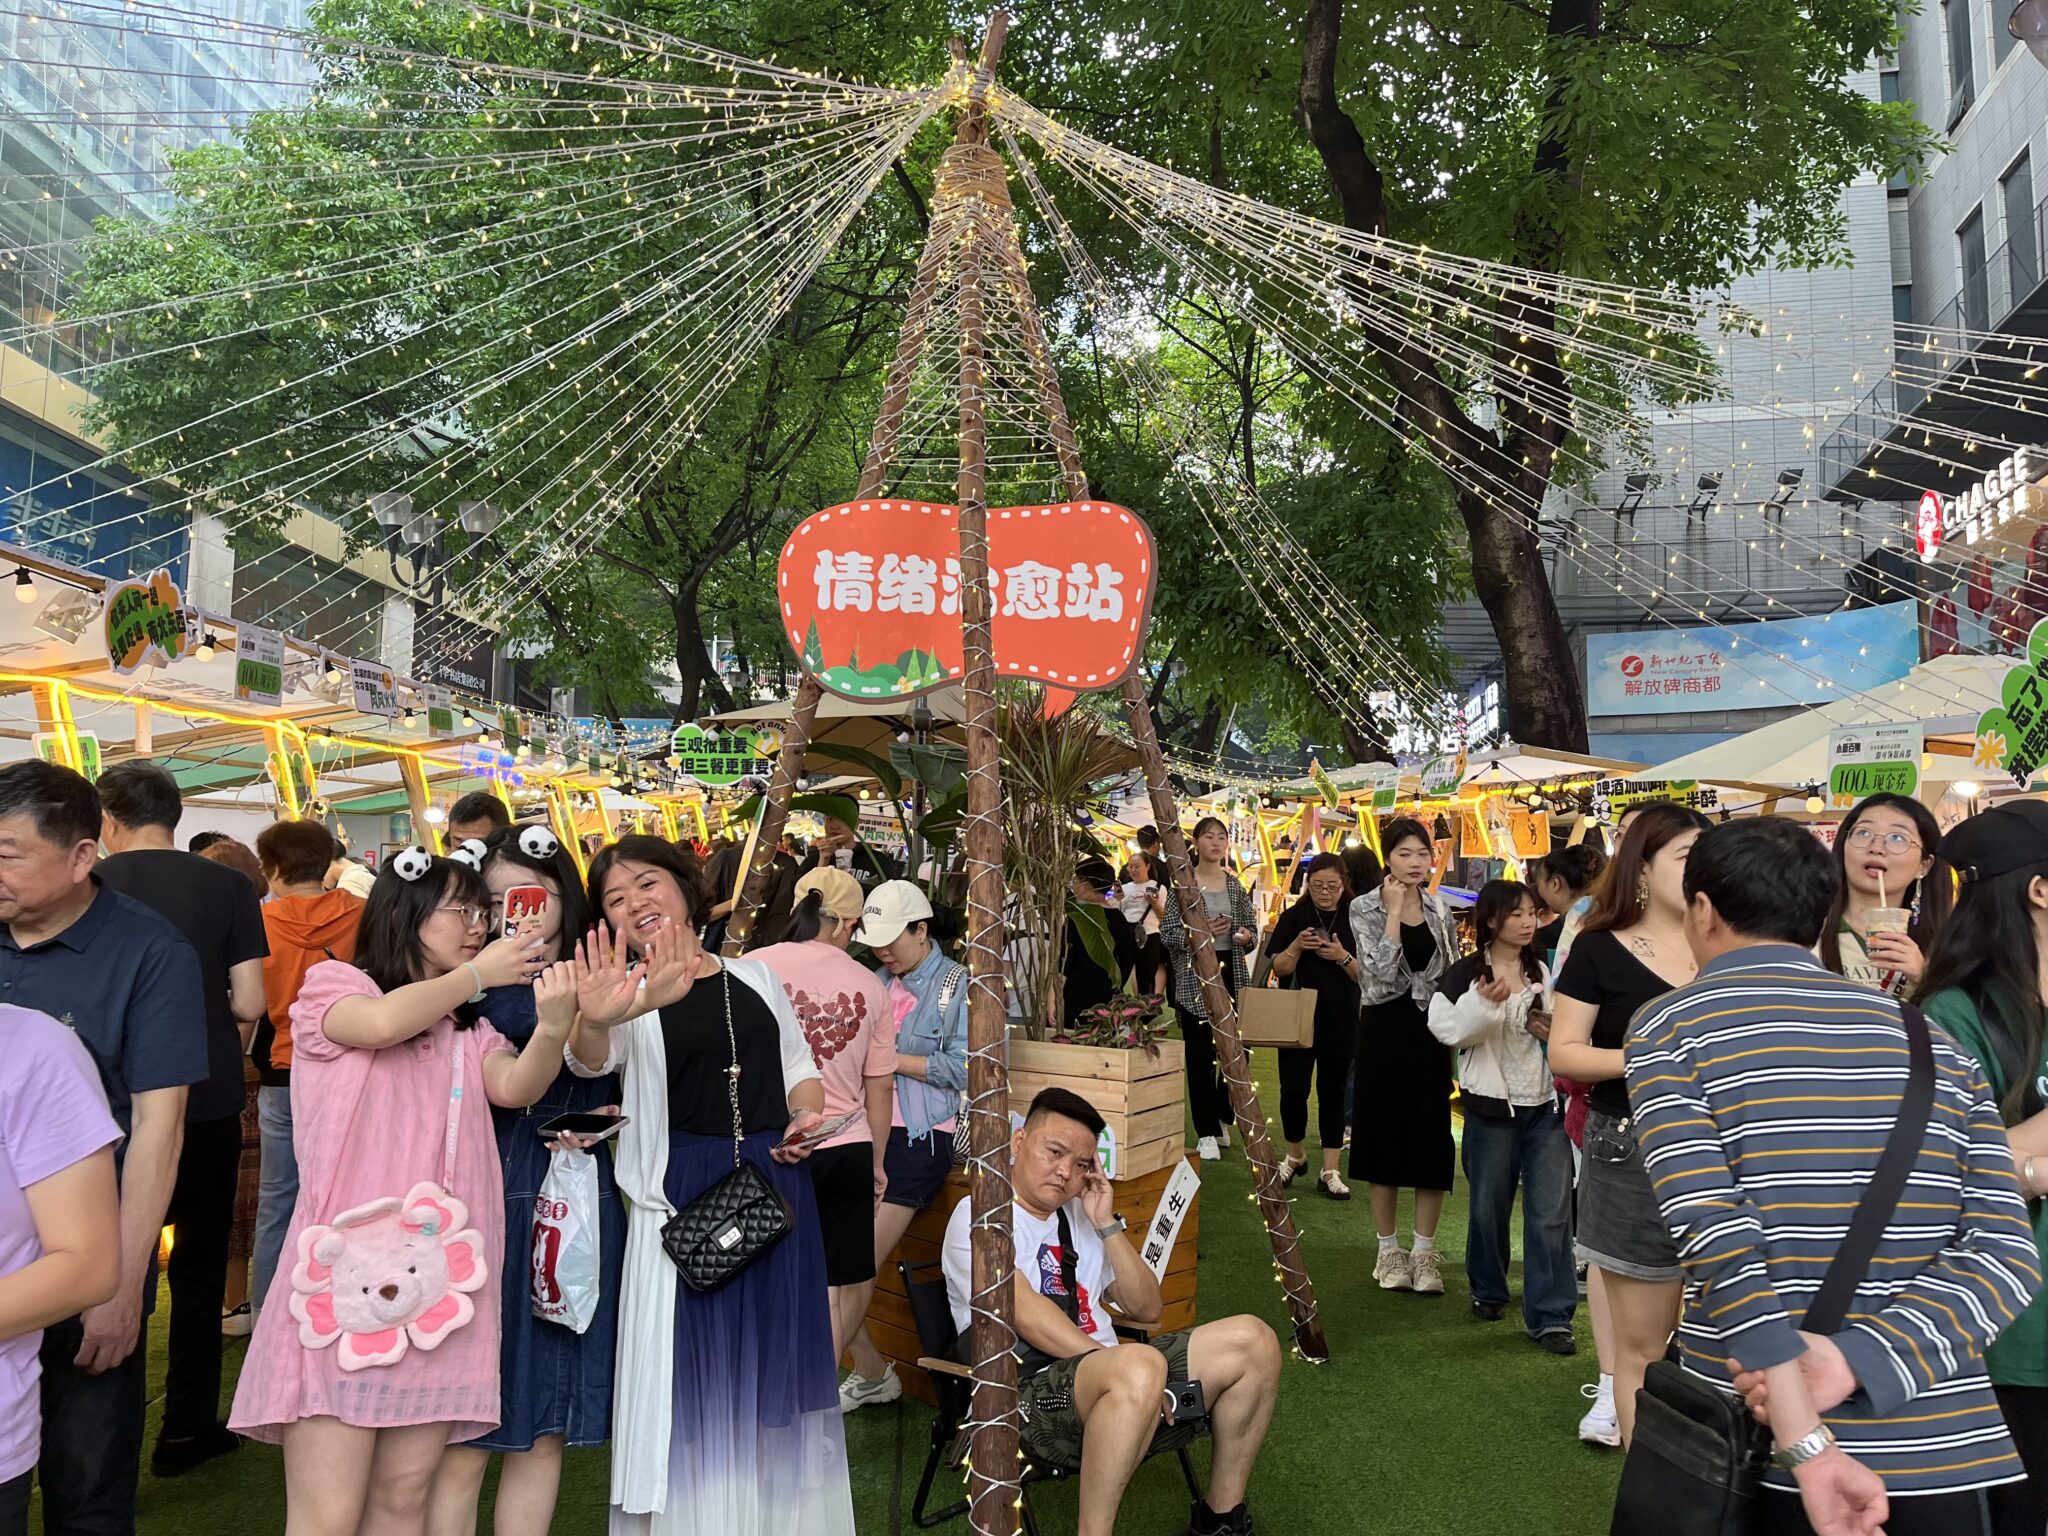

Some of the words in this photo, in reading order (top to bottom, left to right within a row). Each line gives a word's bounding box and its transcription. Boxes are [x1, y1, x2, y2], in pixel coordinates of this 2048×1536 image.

[1943, 447, 2028, 531] CHAGEE
[147, 609, 186, 646] 南北东西
[1650, 652, 1721, 669] 新世纪百货
[1624, 676, 1721, 696] 解放碑商都
[750, 721, 767, 737] Not
[673, 737, 747, 754] 三观很重要
[681, 757, 770, 775] 但三餐更重要
[1873, 772, 1906, 791] 现金券
